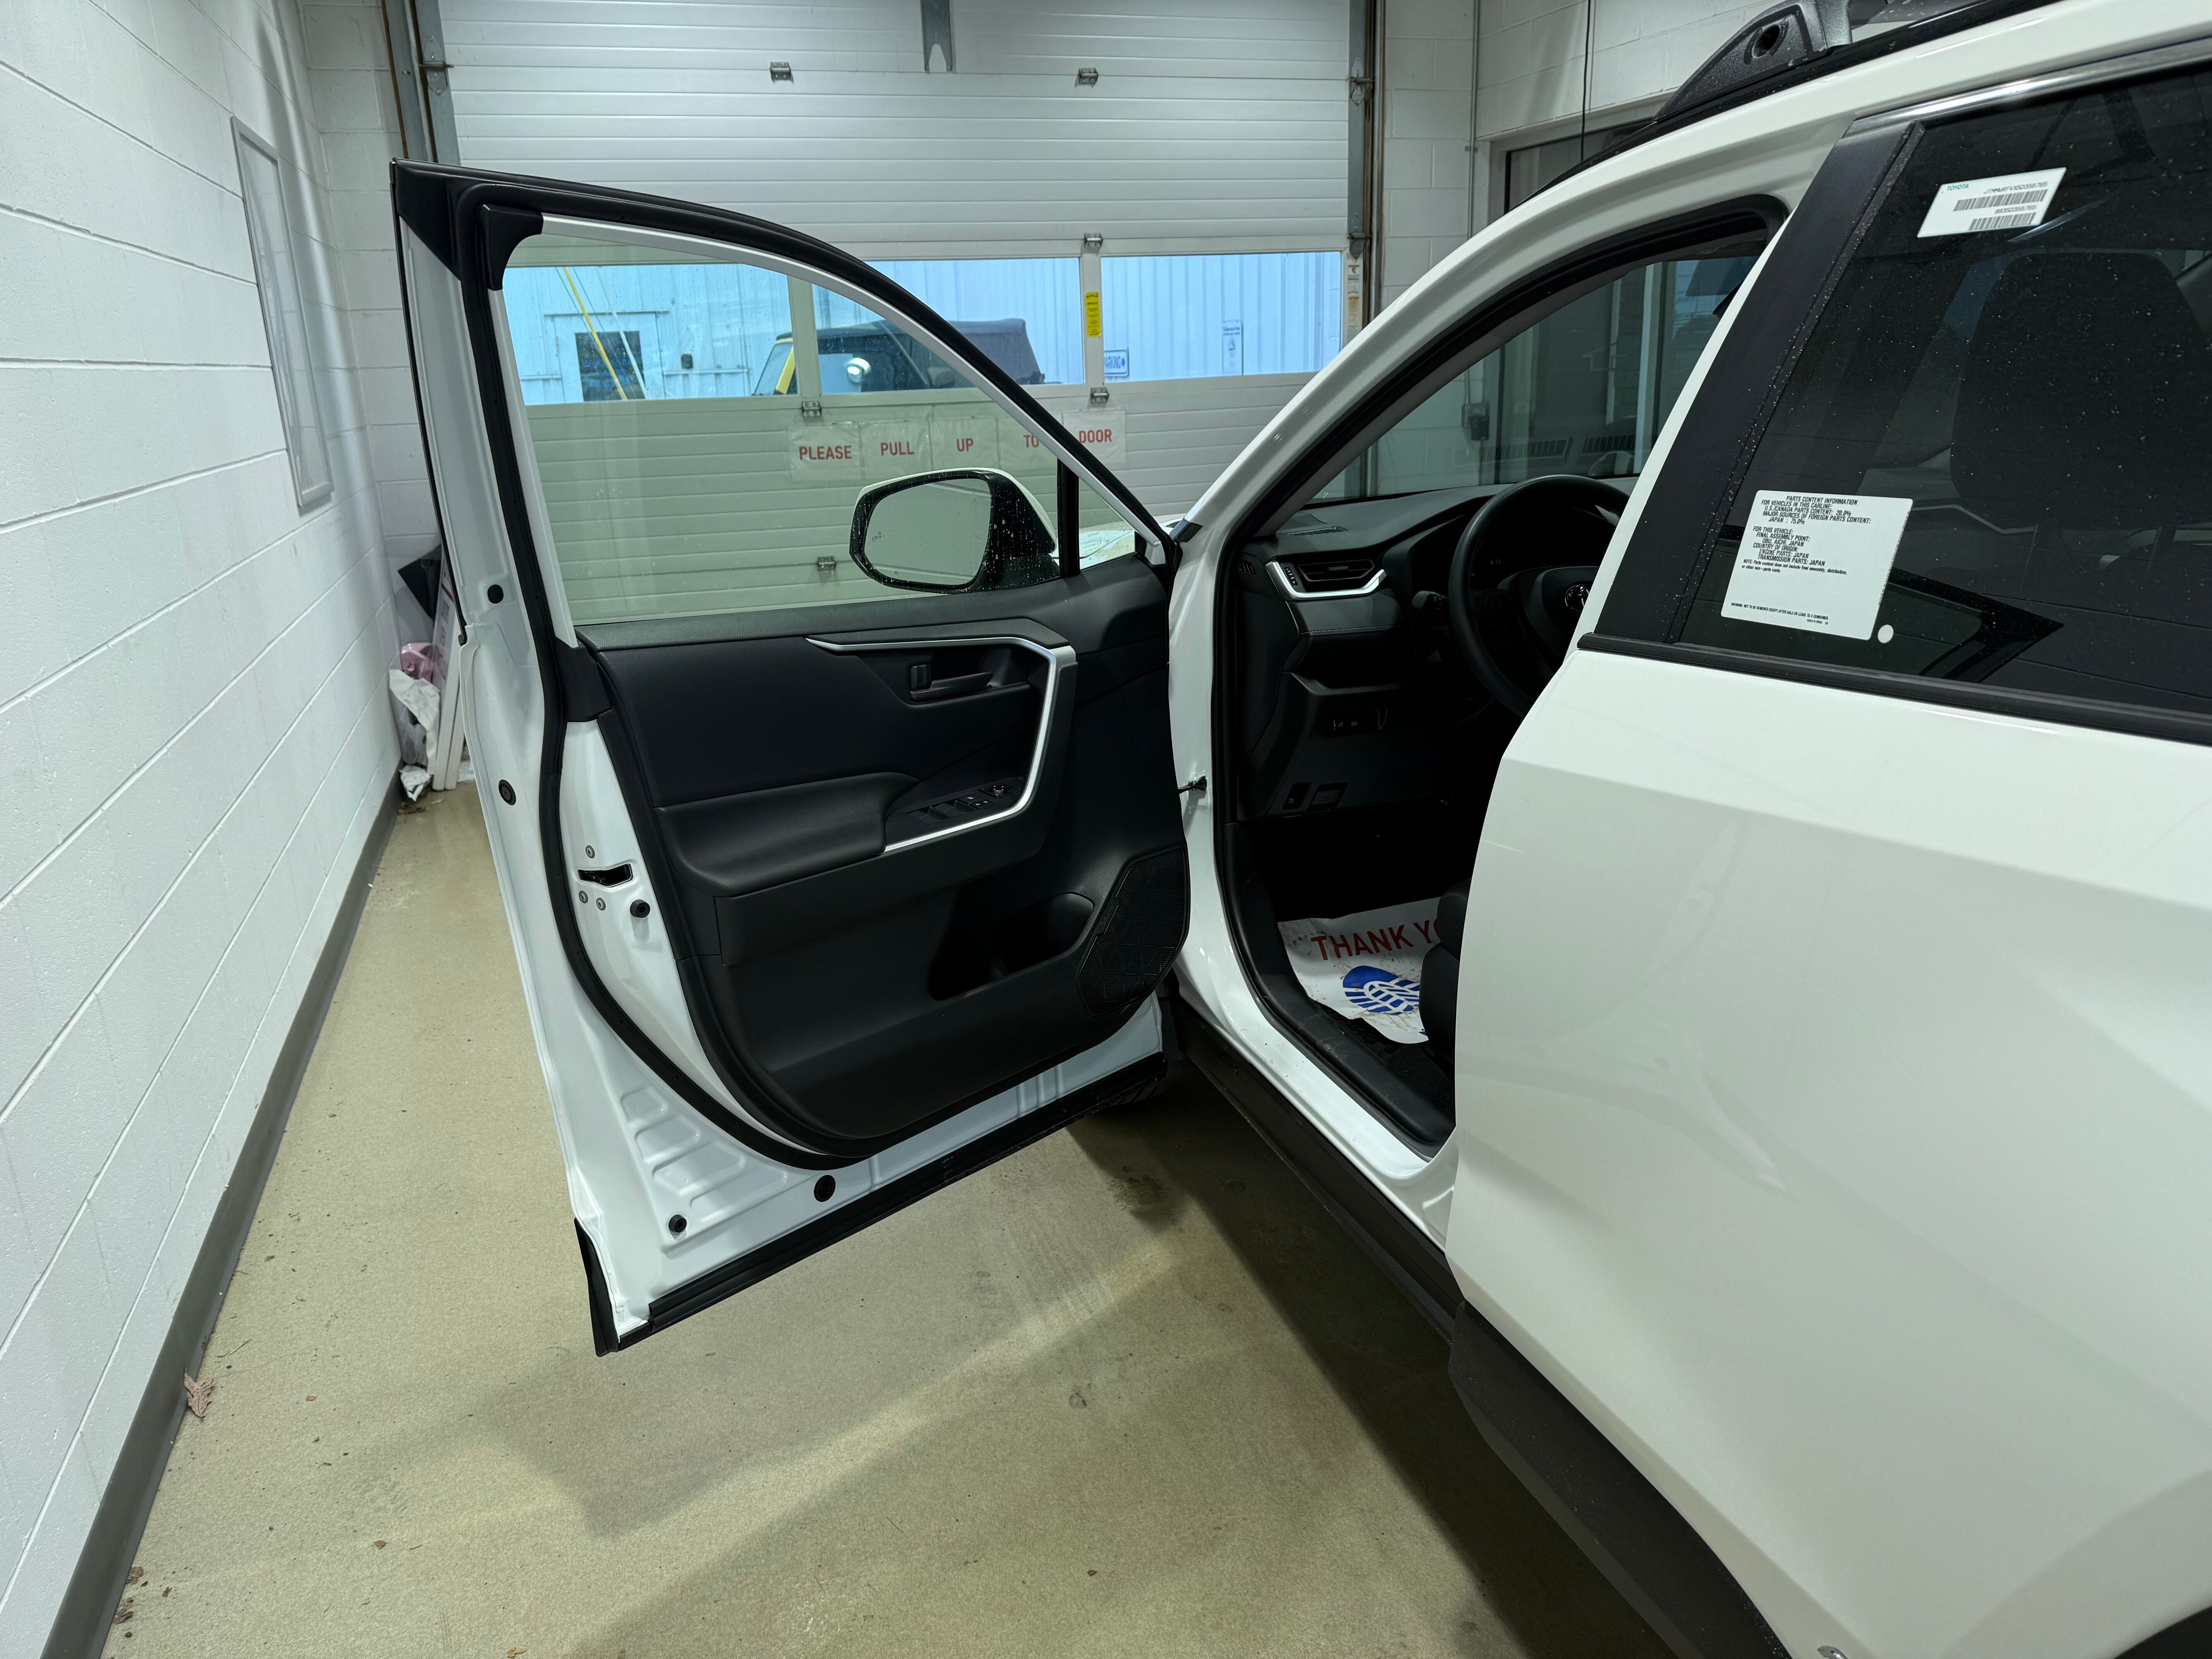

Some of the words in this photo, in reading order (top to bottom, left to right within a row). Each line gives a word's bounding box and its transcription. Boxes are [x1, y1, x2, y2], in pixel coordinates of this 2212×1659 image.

[1104, 356, 1121, 369] ARKING
[799, 445, 852, 460] PLEASE
[880, 441, 914, 456] PULL
[957, 438, 974, 452] UP
[1024, 434, 1039, 448] TO
[1079, 429, 1112, 443] DOOR
[1758, 554, 1791, 562] TRANSMISSION
[1310, 925, 1413, 960] THANK
